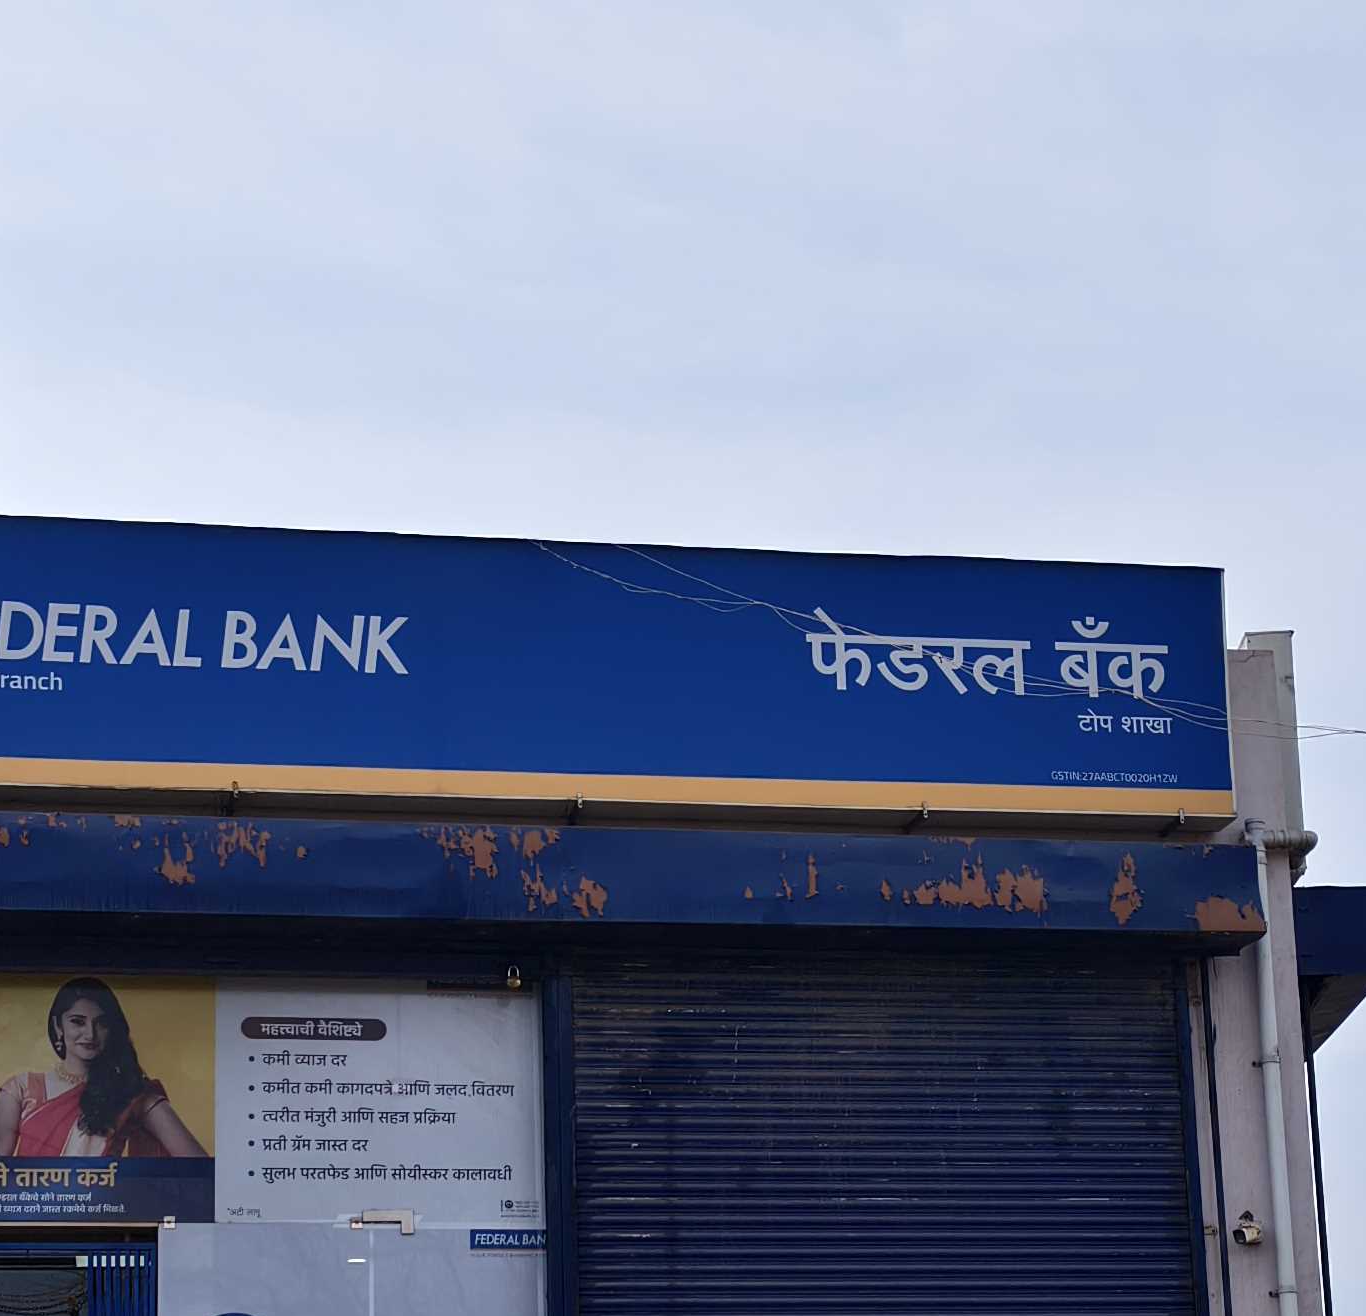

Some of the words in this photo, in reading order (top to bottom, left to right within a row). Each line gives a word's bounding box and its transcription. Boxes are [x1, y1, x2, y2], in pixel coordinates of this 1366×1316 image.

[221, 610, 409, 675] BANK
[805, 607, 1031, 695] फेडरल
[1055, 617, 1168, 698] बँक
[1078, 708, 1112, 733] टोप
[1121, 715, 1172, 735] शाखा
[262, 1050, 291, 1066] कमी
[295, 1054, 327, 1066] व्याज
[331, 1054, 348, 1067] दर
[262, 1078, 300, 1095] कमीत
[304, 1078, 333, 1095] कमी
[336, 1080, 394, 1096] कागदपत्रे
[396, 1080, 431, 1096] आणि
[471, 1081, 515, 1097] वितरण
[262, 1107, 300, 1123] त्वरीत
[304, 1107, 336, 1127] मंजुरी
[341, 1107, 374, 1123] आणि
[378, 1111, 410, 1124] सहज
[413, 1108, 456, 1124] प्रक्रिया
[262, 1135, 287, 1151] प्रती
[290, 1135, 311, 1151] ग्रॅम
[315, 1138, 348, 1151] जास्त
[351, 1139, 370, 1152] दर
[14, 1168, 72, 1188] तारण
[76, 1162, 118, 1187] कर्ज
[262, 1166, 297, 1183] सुलभ
[300, 1164, 350, 1180] परतफेड
[354, 1164, 388, 1180] आणि
[391, 1164, 450, 1180] सोयीस्कर
[452, 1165, 513, 1181] कालावधी
[475, 1233, 520, 1245] FEDERAL
[522, 1233, 547, 1245] BAN
